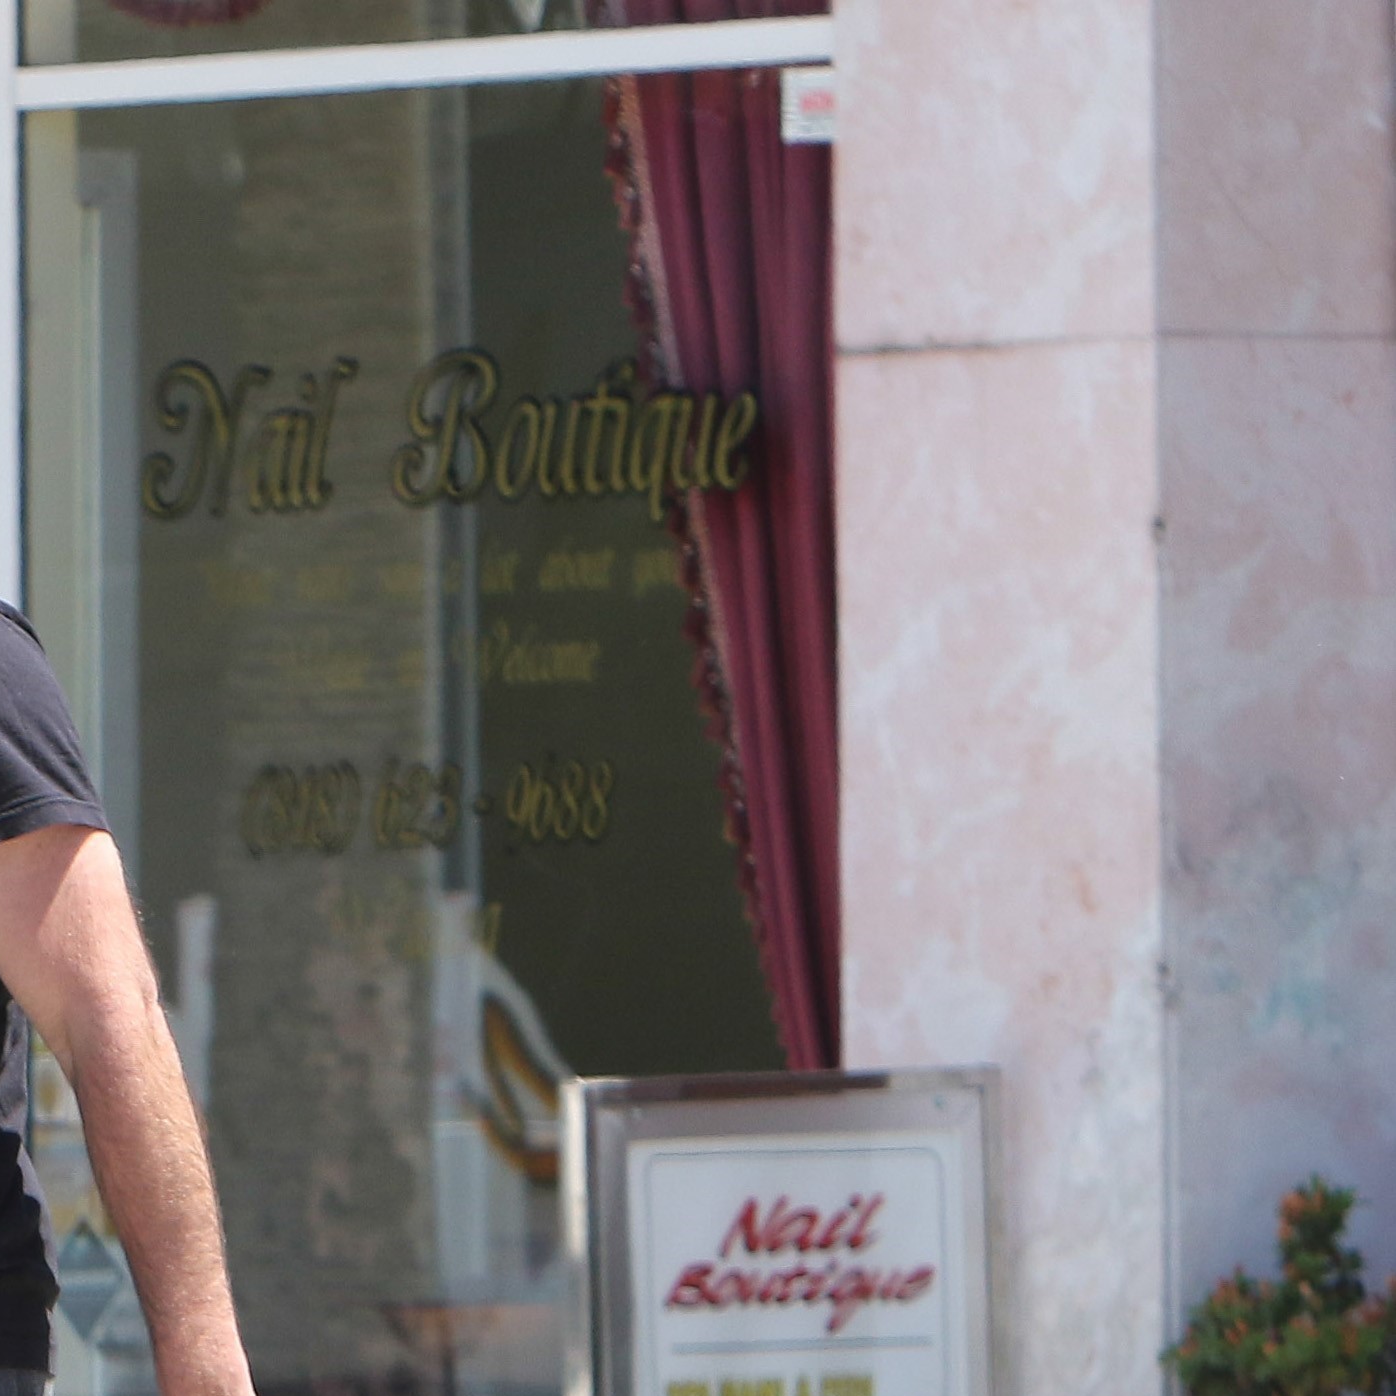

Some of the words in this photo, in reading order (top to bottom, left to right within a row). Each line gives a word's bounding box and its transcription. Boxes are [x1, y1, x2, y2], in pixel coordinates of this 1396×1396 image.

[142, 357, 360, 520] Nail
[392, 347, 757, 520] Boutique
[718, 1192, 885, 1258] Nail
[665, 1259, 937, 1333] Boutique
